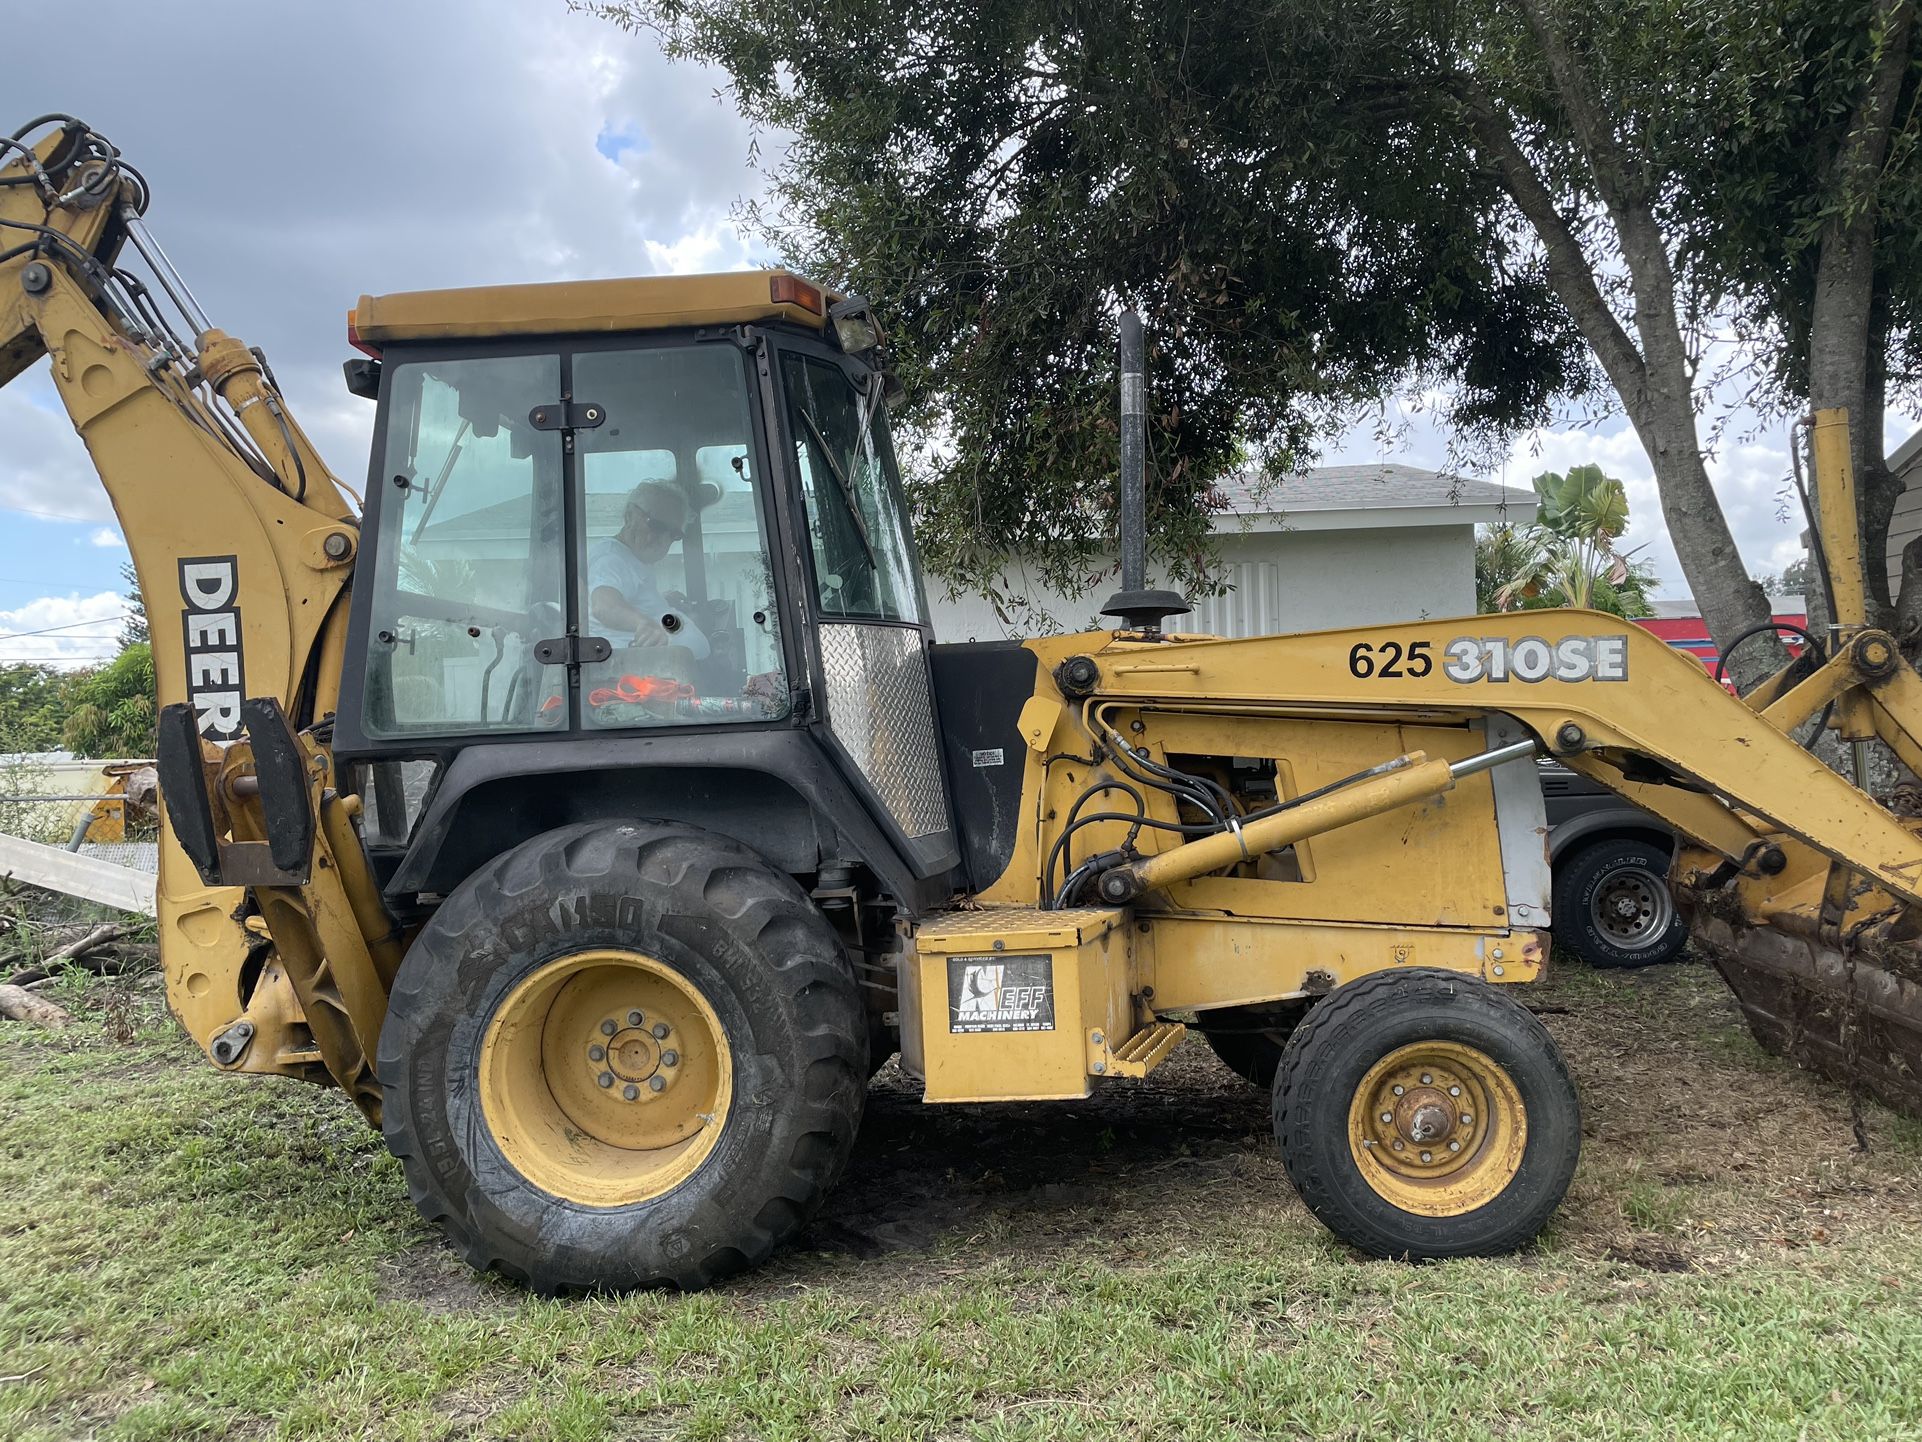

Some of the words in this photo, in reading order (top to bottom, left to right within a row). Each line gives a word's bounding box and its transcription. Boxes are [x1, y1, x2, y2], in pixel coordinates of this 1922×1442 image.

[179, 555, 246, 748] DEER
[1349, 641, 1432, 678] 625
[1445, 637, 1627, 682] 310SE
[958, 1009, 1039, 1020] MACHINERY
